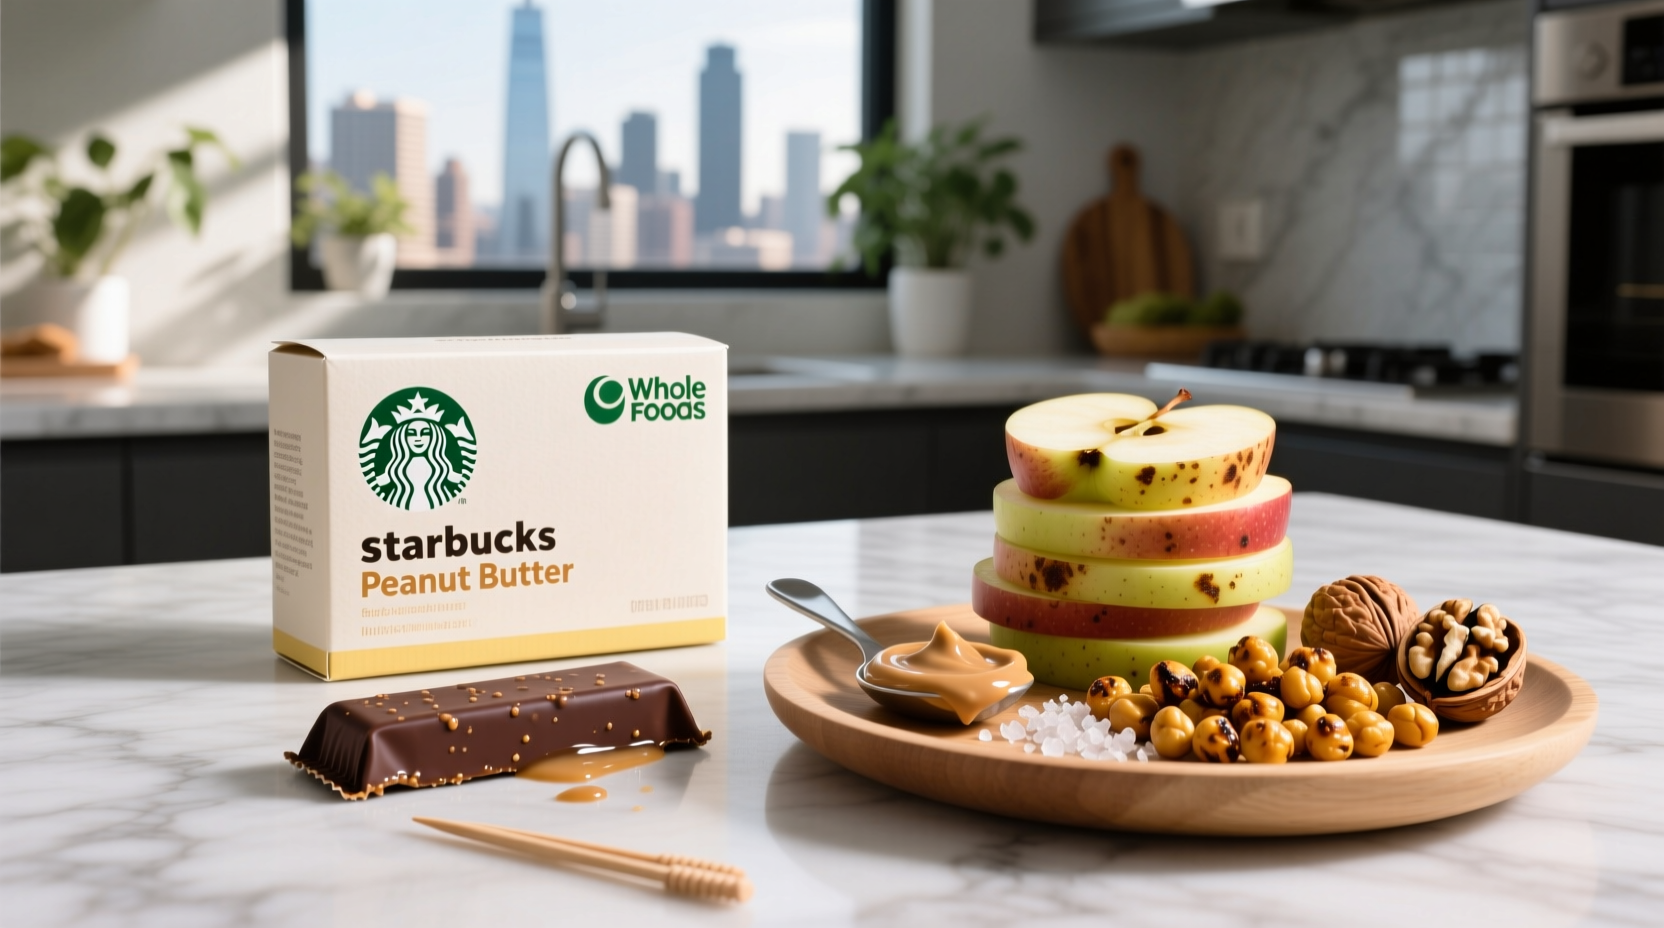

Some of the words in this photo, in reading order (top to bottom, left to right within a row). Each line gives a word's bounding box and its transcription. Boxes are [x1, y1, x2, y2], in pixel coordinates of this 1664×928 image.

[627, 374, 707, 401] Whole
[361, 520, 556, 564] starbucks
[361, 566, 471, 598] Peanut
[479, 561, 574, 590] Butter
